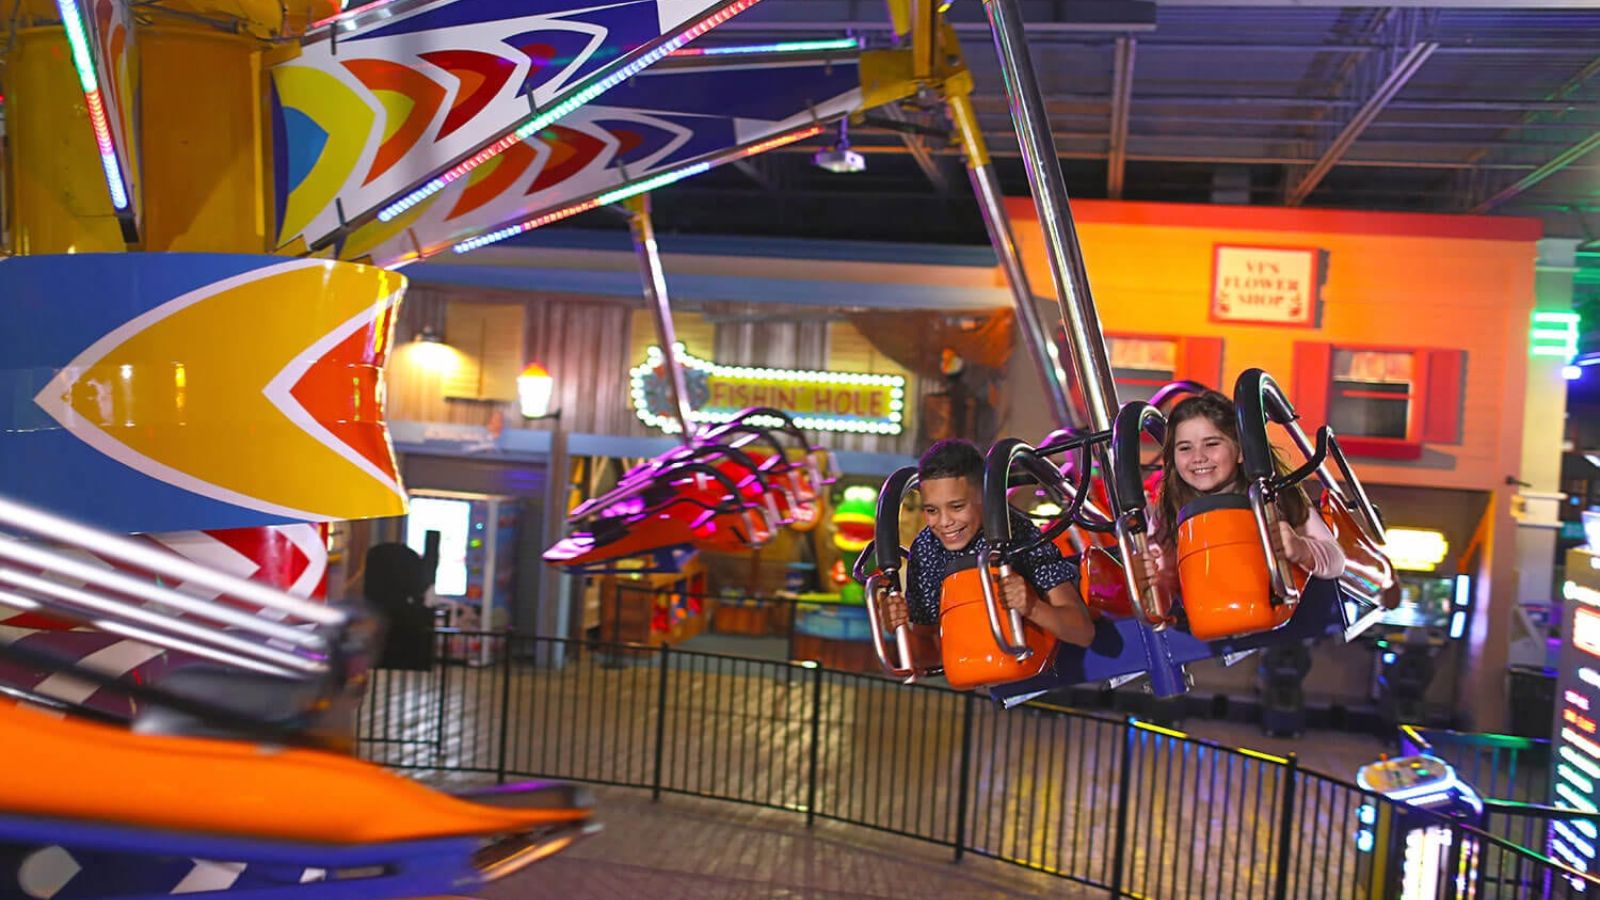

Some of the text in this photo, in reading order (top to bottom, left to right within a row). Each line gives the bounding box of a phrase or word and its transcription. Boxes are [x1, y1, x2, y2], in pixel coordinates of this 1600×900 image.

[1223, 276, 1299, 291] FLOWER
[1238, 293, 1285, 306] SHOP
[712, 381, 805, 411] FISHIN'
[813, 388, 884, 417] HOLE
